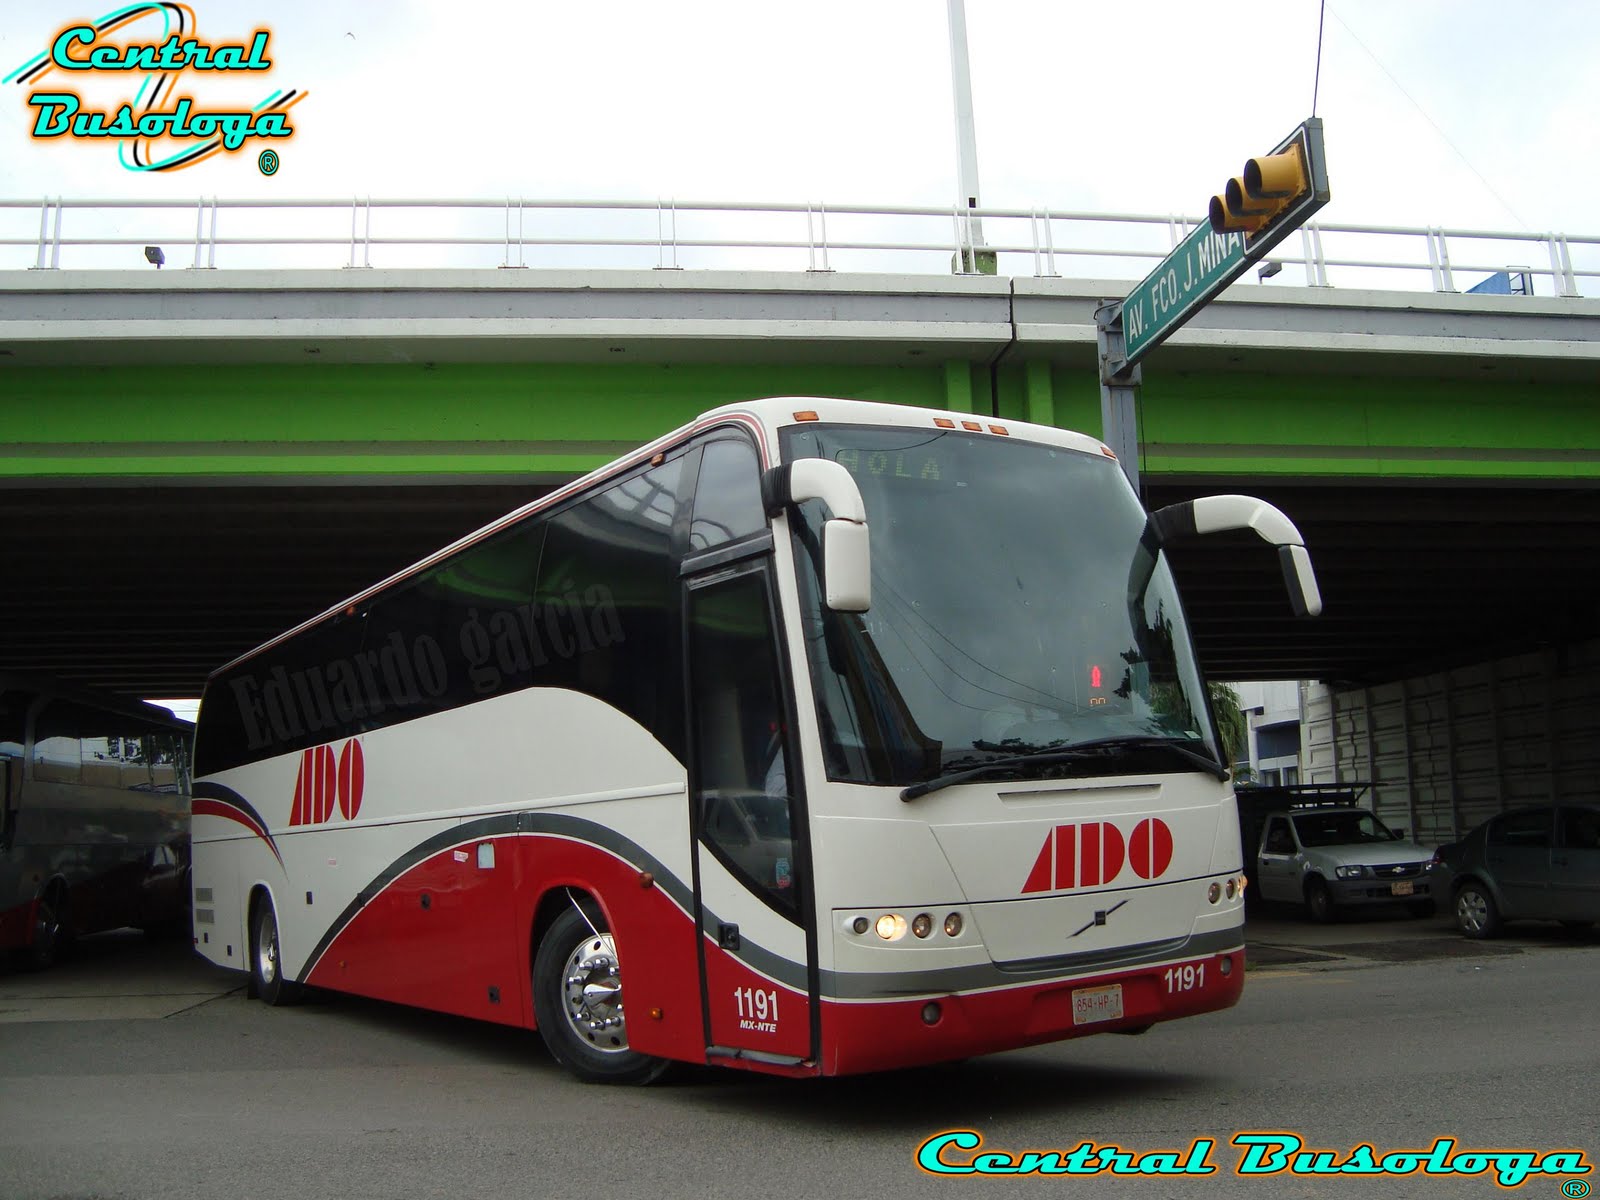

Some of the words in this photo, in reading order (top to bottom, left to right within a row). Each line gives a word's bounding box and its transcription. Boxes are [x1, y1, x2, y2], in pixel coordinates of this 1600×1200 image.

[1129, 298, 1149, 344] AV.
[1151, 268, 1183, 322] FCO.
[1183, 252, 1198, 292] J.
[1198, 230, 1241, 279] MINA
[289, 738, 364, 826] ADO
[1021, 818, 1173, 893] ADO
[734, 986, 778, 1021] 1191
[1164, 963, 1205, 993] 1191
[740, 1020, 776, 1033] MX-NTE
